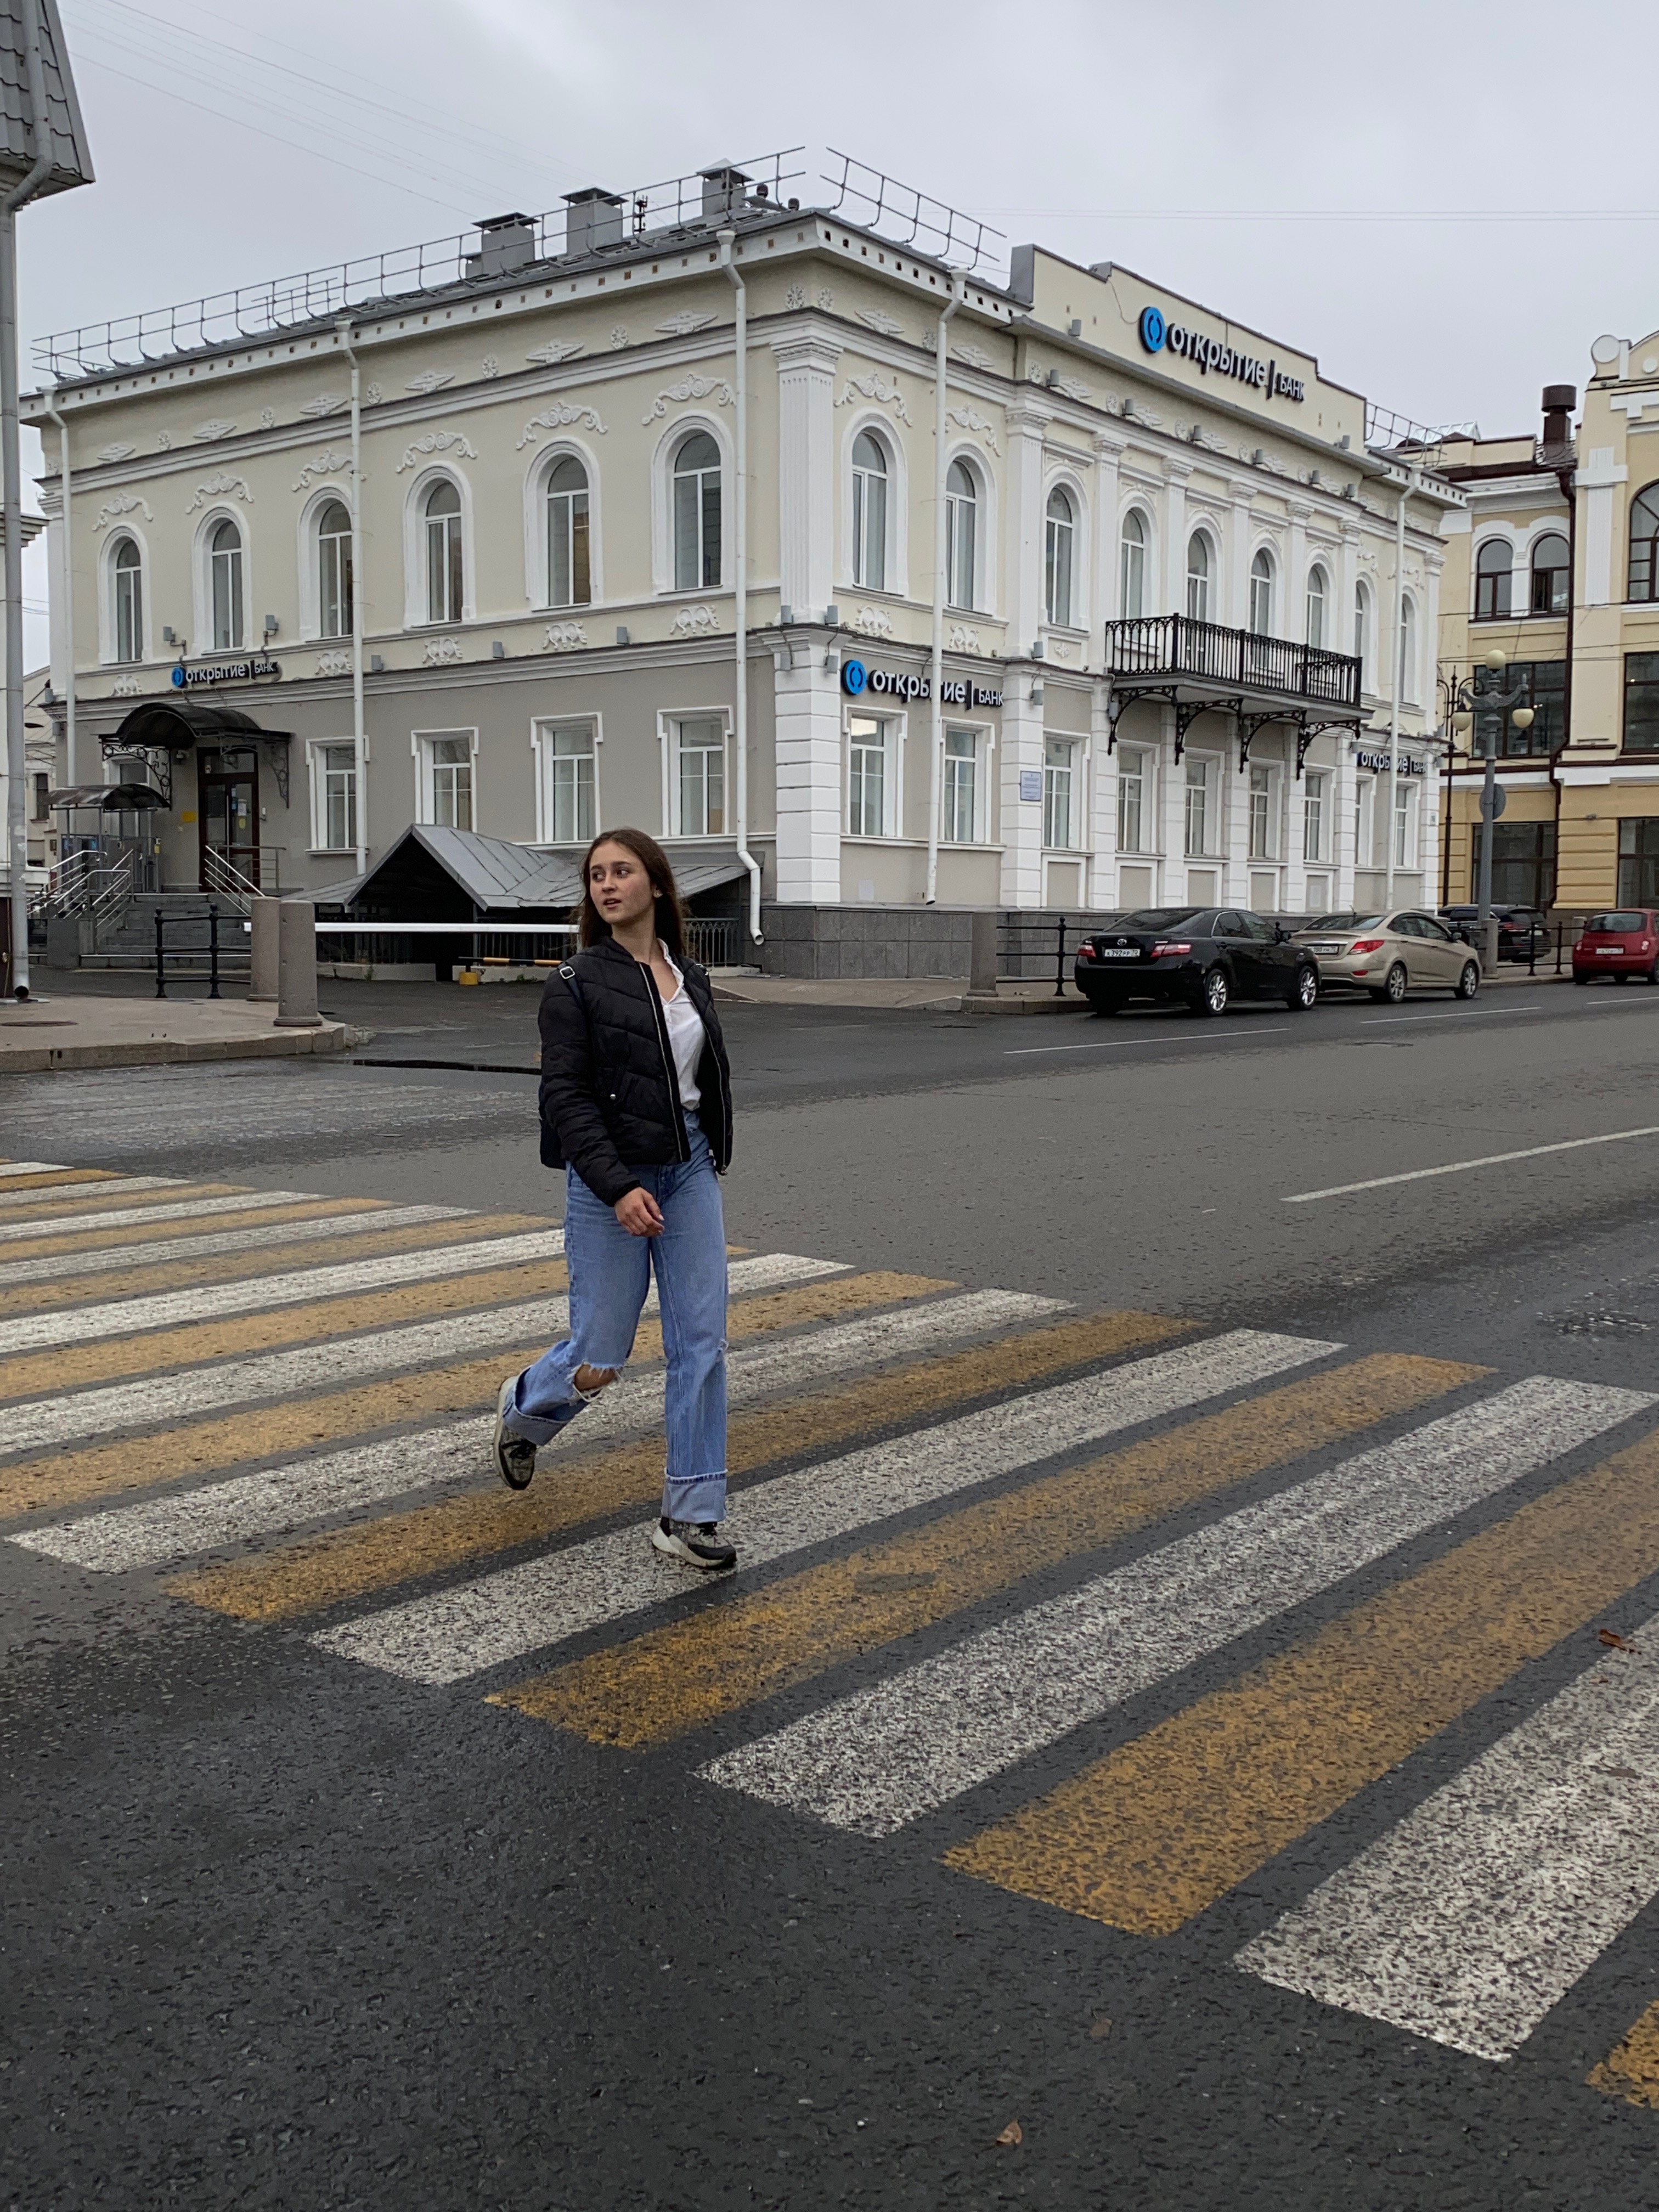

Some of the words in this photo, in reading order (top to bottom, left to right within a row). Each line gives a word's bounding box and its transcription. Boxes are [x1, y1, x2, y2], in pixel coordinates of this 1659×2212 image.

[1170, 324, 1267, 387] открытие
[1280, 375, 1305, 399] БАНК
[185, 664, 246, 684] открытие
[255, 662, 274, 673] БАНК
[872, 670, 966, 703] открыие
[978, 688, 1004, 707] БАНК
